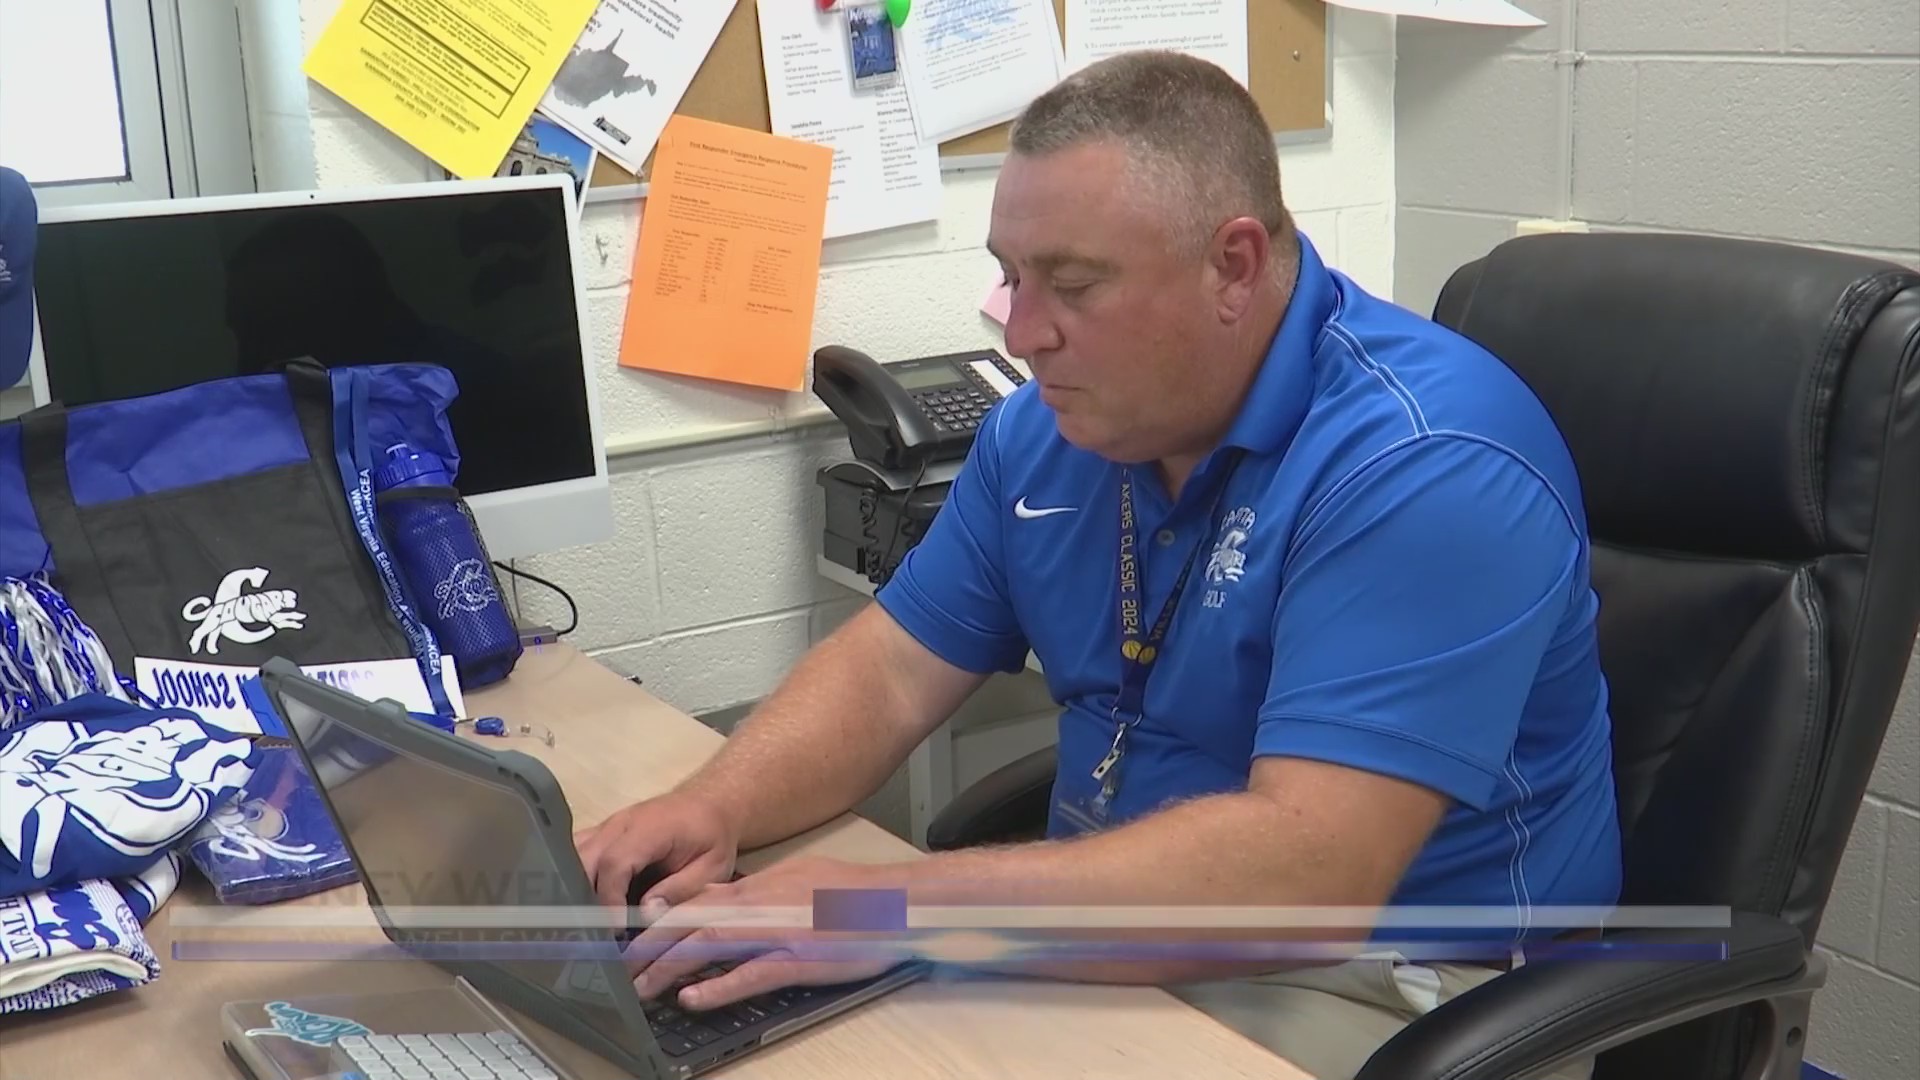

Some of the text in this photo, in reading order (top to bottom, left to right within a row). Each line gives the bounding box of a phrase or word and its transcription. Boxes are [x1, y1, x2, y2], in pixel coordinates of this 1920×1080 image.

[350, 487, 366, 517] West
[358, 513, 381, 555] Virginia
[375, 549, 404, 604] Education
[1119, 534, 1137, 593] CLASSIC
[1121, 599, 1139, 637] 2024
